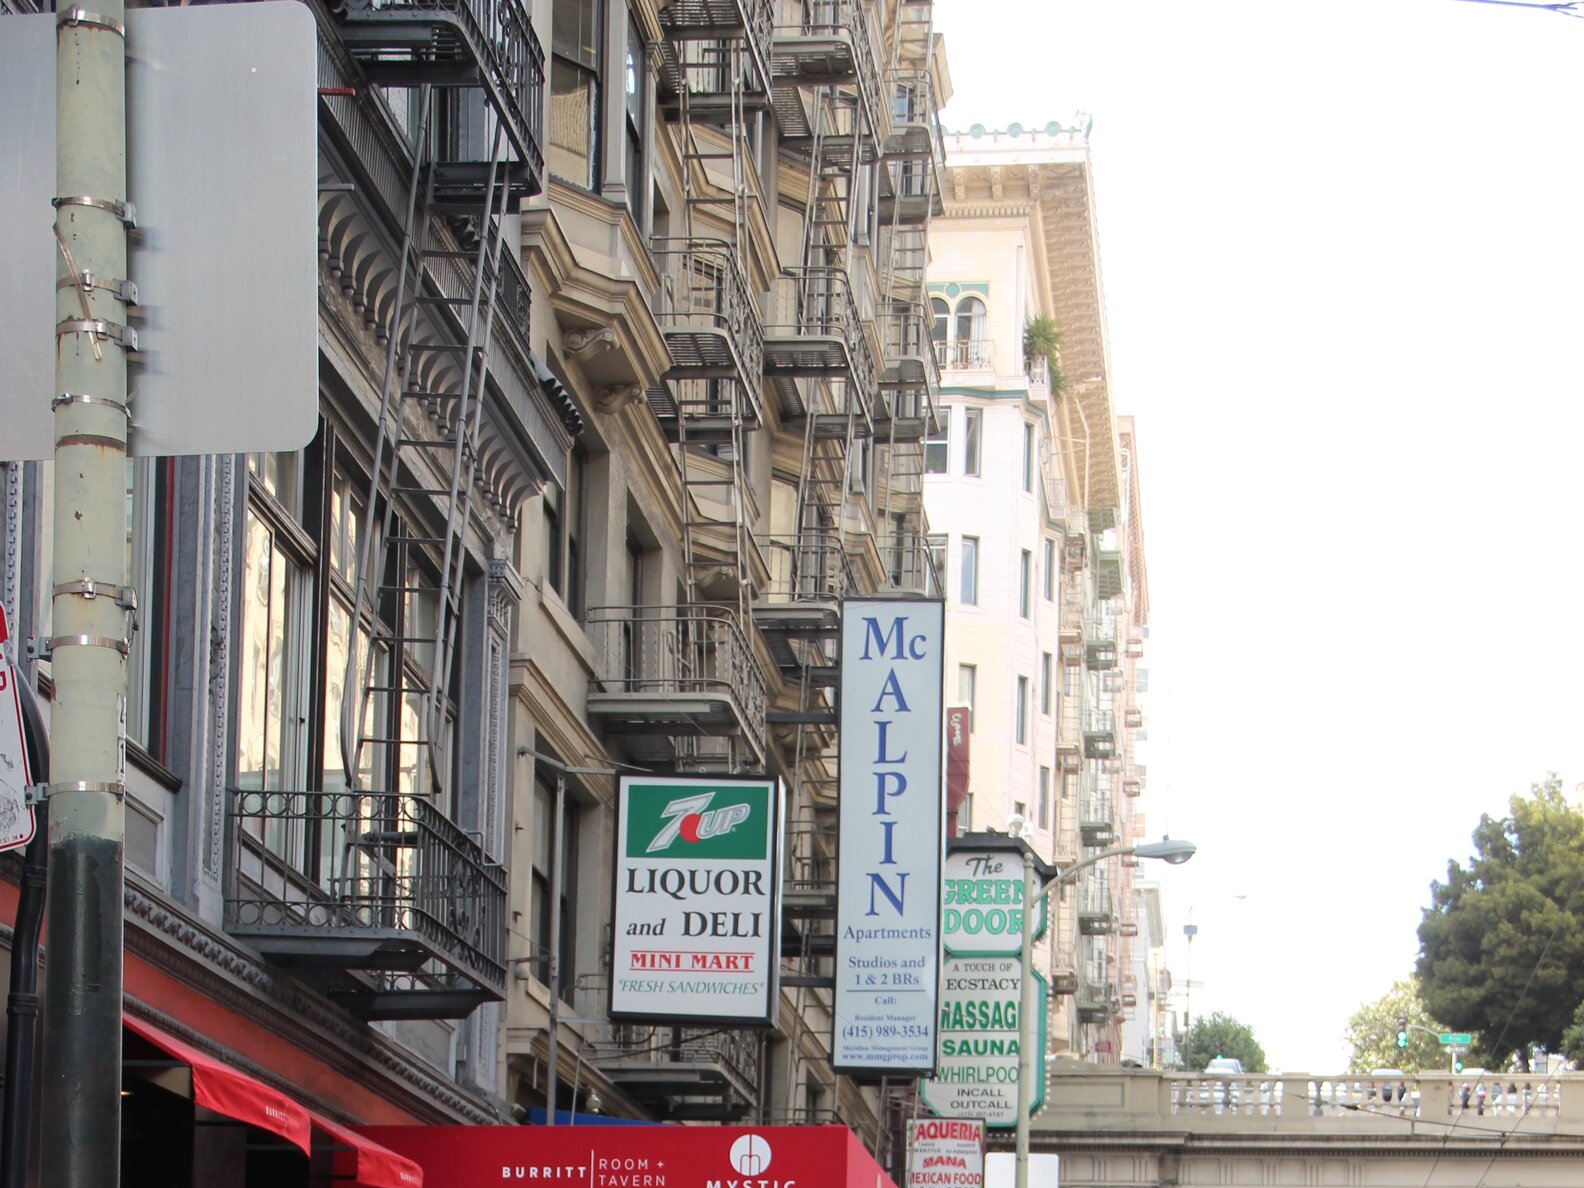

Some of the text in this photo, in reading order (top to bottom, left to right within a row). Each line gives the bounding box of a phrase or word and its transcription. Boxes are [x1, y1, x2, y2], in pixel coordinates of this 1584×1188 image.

[965, 853, 1003, 877] The
[625, 868, 766, 900] LIQUOR
[625, 911, 763, 938] and DELI
[943, 908, 1025, 935] DOOR
[842, 925, 932, 943] Apartments
[630, 952, 754, 971] MINI MART
[848, 956, 926, 969] Studios and
[952, 962, 1013, 973] A TOUCH OF
[854, 974, 920, 986] 1 & 2 BRs
[945, 978, 1021, 990] ECSTACY
[842, 1024, 929, 1041] (415) 989-3534
[941, 1039, 1020, 1056] SAUNA
[938, 1066, 1019, 1083] WHIRLPOO
[957, 1088, 1005, 1097] INCALL
[950, 1100, 1012, 1109] OUTCALL
[915, 1120, 982, 1142] AQUERIA
[599, 1158, 649, 1170] ROOM
[922, 1155, 967, 1170] MANA
[501, 1166, 587, 1179] BURRITT
[953, 1172, 981, 1185] FOOD
[599, 1174, 667, 1187] TAVERN
